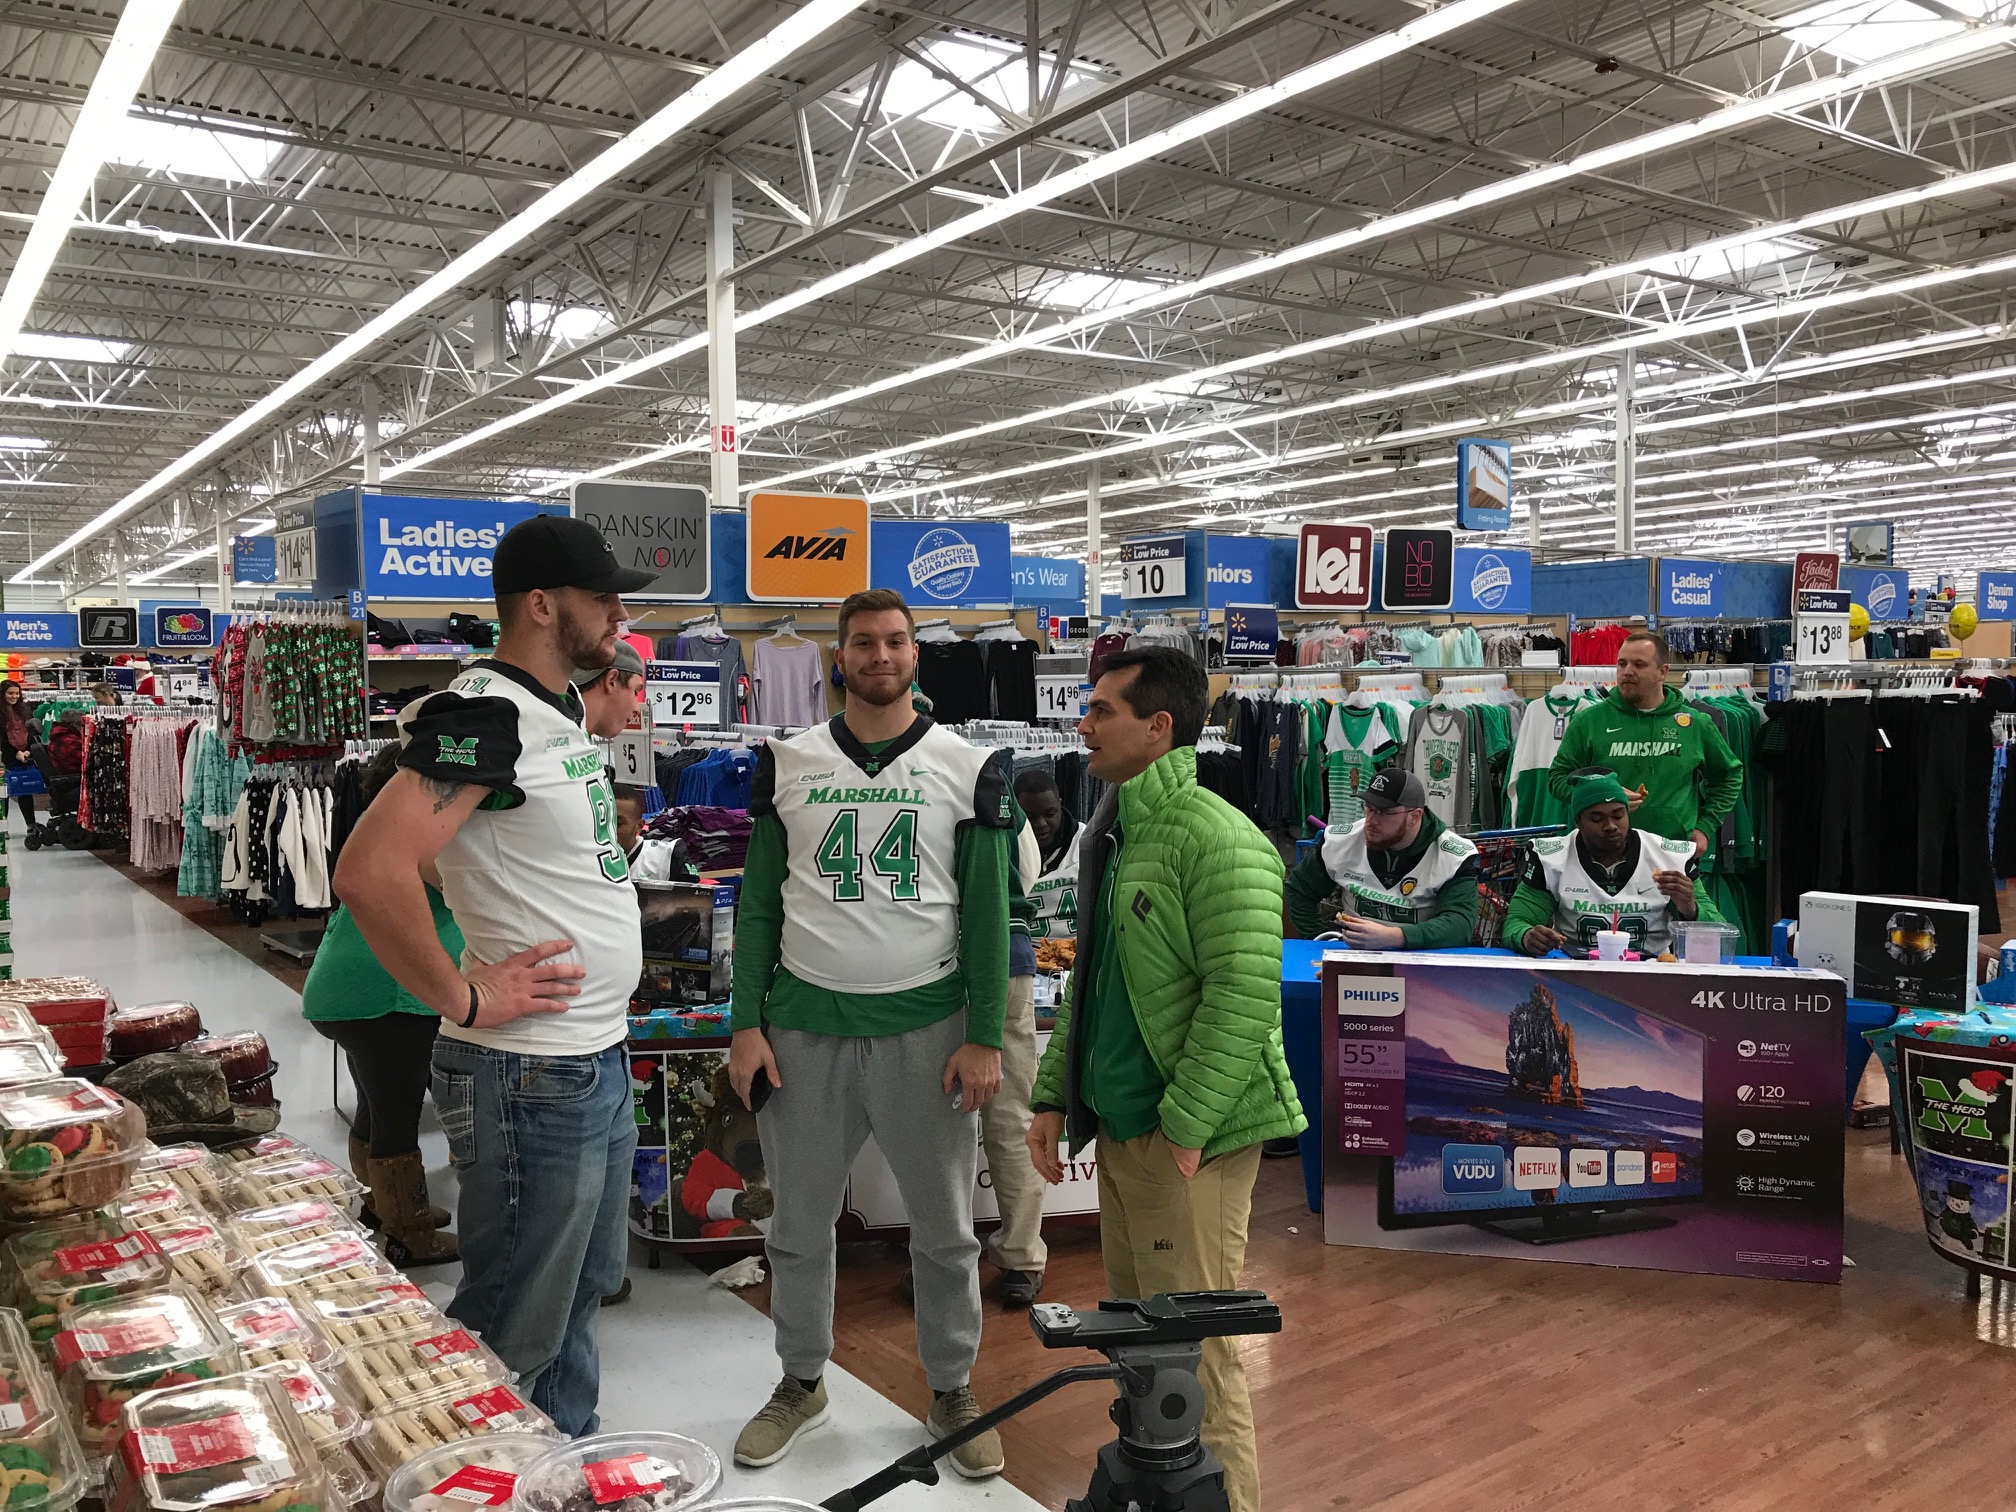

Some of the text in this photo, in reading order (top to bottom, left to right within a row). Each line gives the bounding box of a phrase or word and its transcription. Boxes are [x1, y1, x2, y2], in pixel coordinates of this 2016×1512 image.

[292, 513, 305, 527] Price
[1477, 514, 1508, 524] Fitting Rooms
[379, 518, 505, 549] Ladies'
[764, 535, 848, 561] AVIA
[1134, 547, 1169, 559] Low Price
[1406, 540, 1434, 563] NO
[379, 547, 493, 577] Active
[633, 546, 697, 570] NOW
[912, 547, 973, 573] SATISFACTION
[914, 555, 976, 581] GUARANTEE
[1207, 563, 1252, 584] niors
[930, 576, 948, 586] Quality
[1039, 568, 1068, 586] Wear
[1405, 564, 1433, 587] BO
[1473, 569, 1508, 587] SATISFACTION
[1671, 571, 1714, 589] Ladies'
[1474, 575, 1510, 595] GUARANTEE
[1988, 583, 2014, 597] Denim
[353, 591, 362, 603] B
[1671, 589, 1711, 606] Casual
[1810, 600, 1837, 609] Low Price
[1987, 596, 2008, 613] Shop
[352, 607, 365, 618] 21
[1040, 607, 1047, 617] B
[1201, 610, 1207, 619] B
[1649, 614, 1655, 622] B
[7, 620, 48, 631] Men's
[1038, 619, 1049, 628] 21
[1200, 623, 1208, 631] 20
[7, 631, 52, 641] Active
[1231, 640, 1269, 650] Low Price
[681, 671, 701, 679] Price
[1774, 668, 1786, 685] B
[804, 786, 926, 805] MARSHALL
[814, 808, 922, 902] 44
[1344, 990, 1399, 1002] PHILIPS
[1690, 991, 1831, 1013] 4K Ultra HD
[1928, 991, 1958, 999] HALO
[1344, 1023, 1395, 1032] 5000 series
[1759, 1085, 1785, 1098] 120
[1925, 1098, 1986, 1117] THE HERD
[1759, 1132, 1793, 1140] Wireless
[1453, 1164, 1496, 1180] VUDU
[1519, 1162, 1557, 1176] NETFLIX
[1577, 1161, 1601, 1175] YouTube
[1617, 1164, 1643, 1172] pandora
[1758, 1176, 1816, 1187] High Dynamic
[1758, 1184, 1785, 1193] Range
